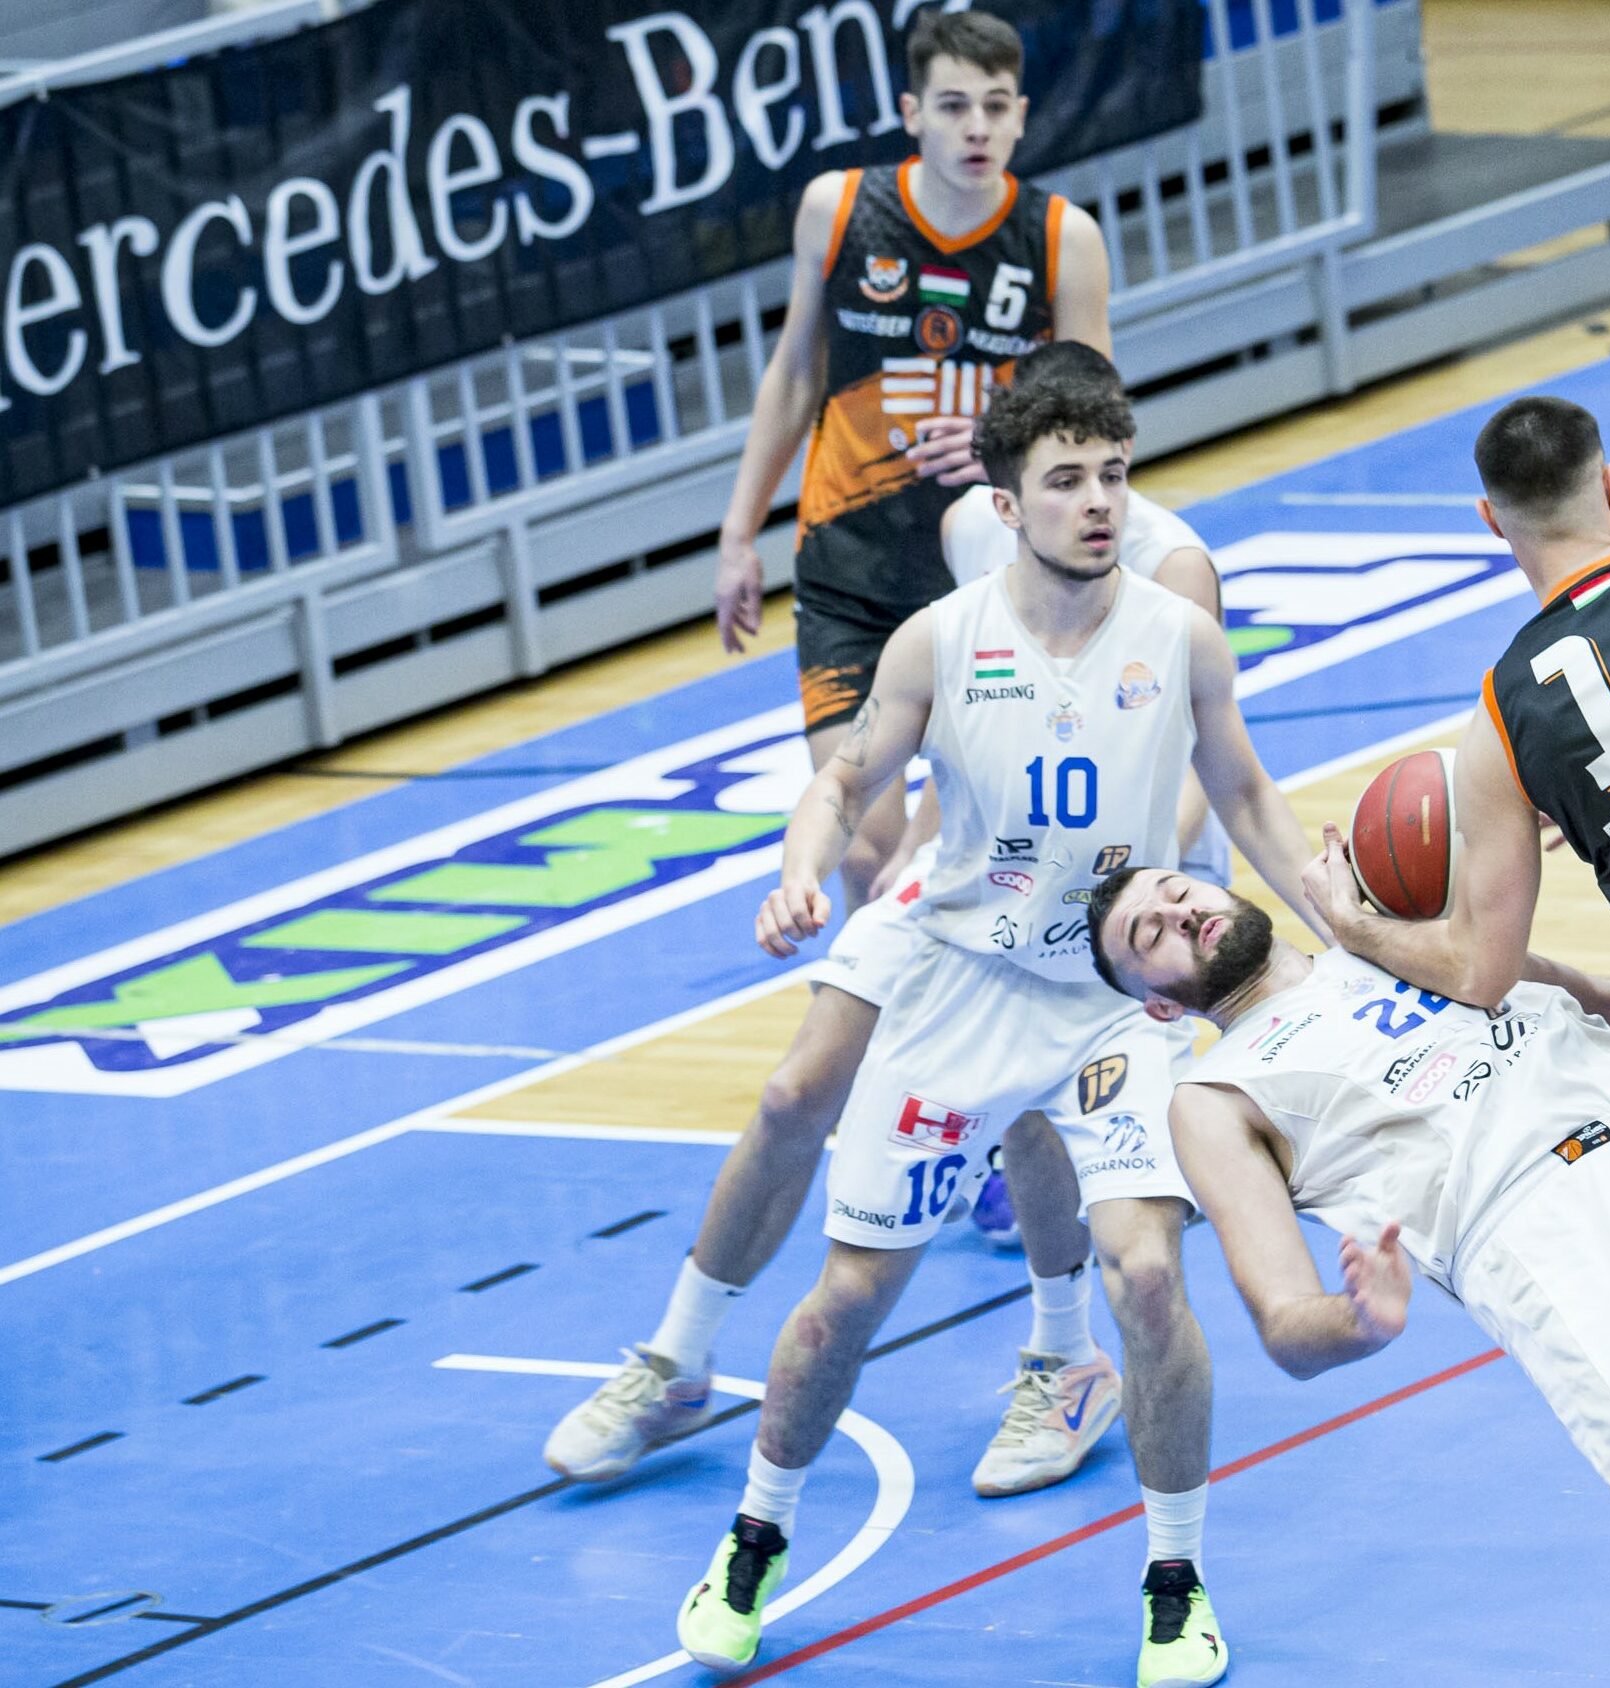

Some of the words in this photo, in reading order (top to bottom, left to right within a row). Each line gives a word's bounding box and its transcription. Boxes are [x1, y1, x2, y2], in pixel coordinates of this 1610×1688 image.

[0, 0, 972, 412] ercedes-Ben
[984, 262, 1034, 331] 5
[965, 684, 1035, 705] SPALDING
[1025, 756, 1098, 829] 10
[1261, 1012, 1322, 1064] SPALDING
[902, 1153, 968, 1226] 10
